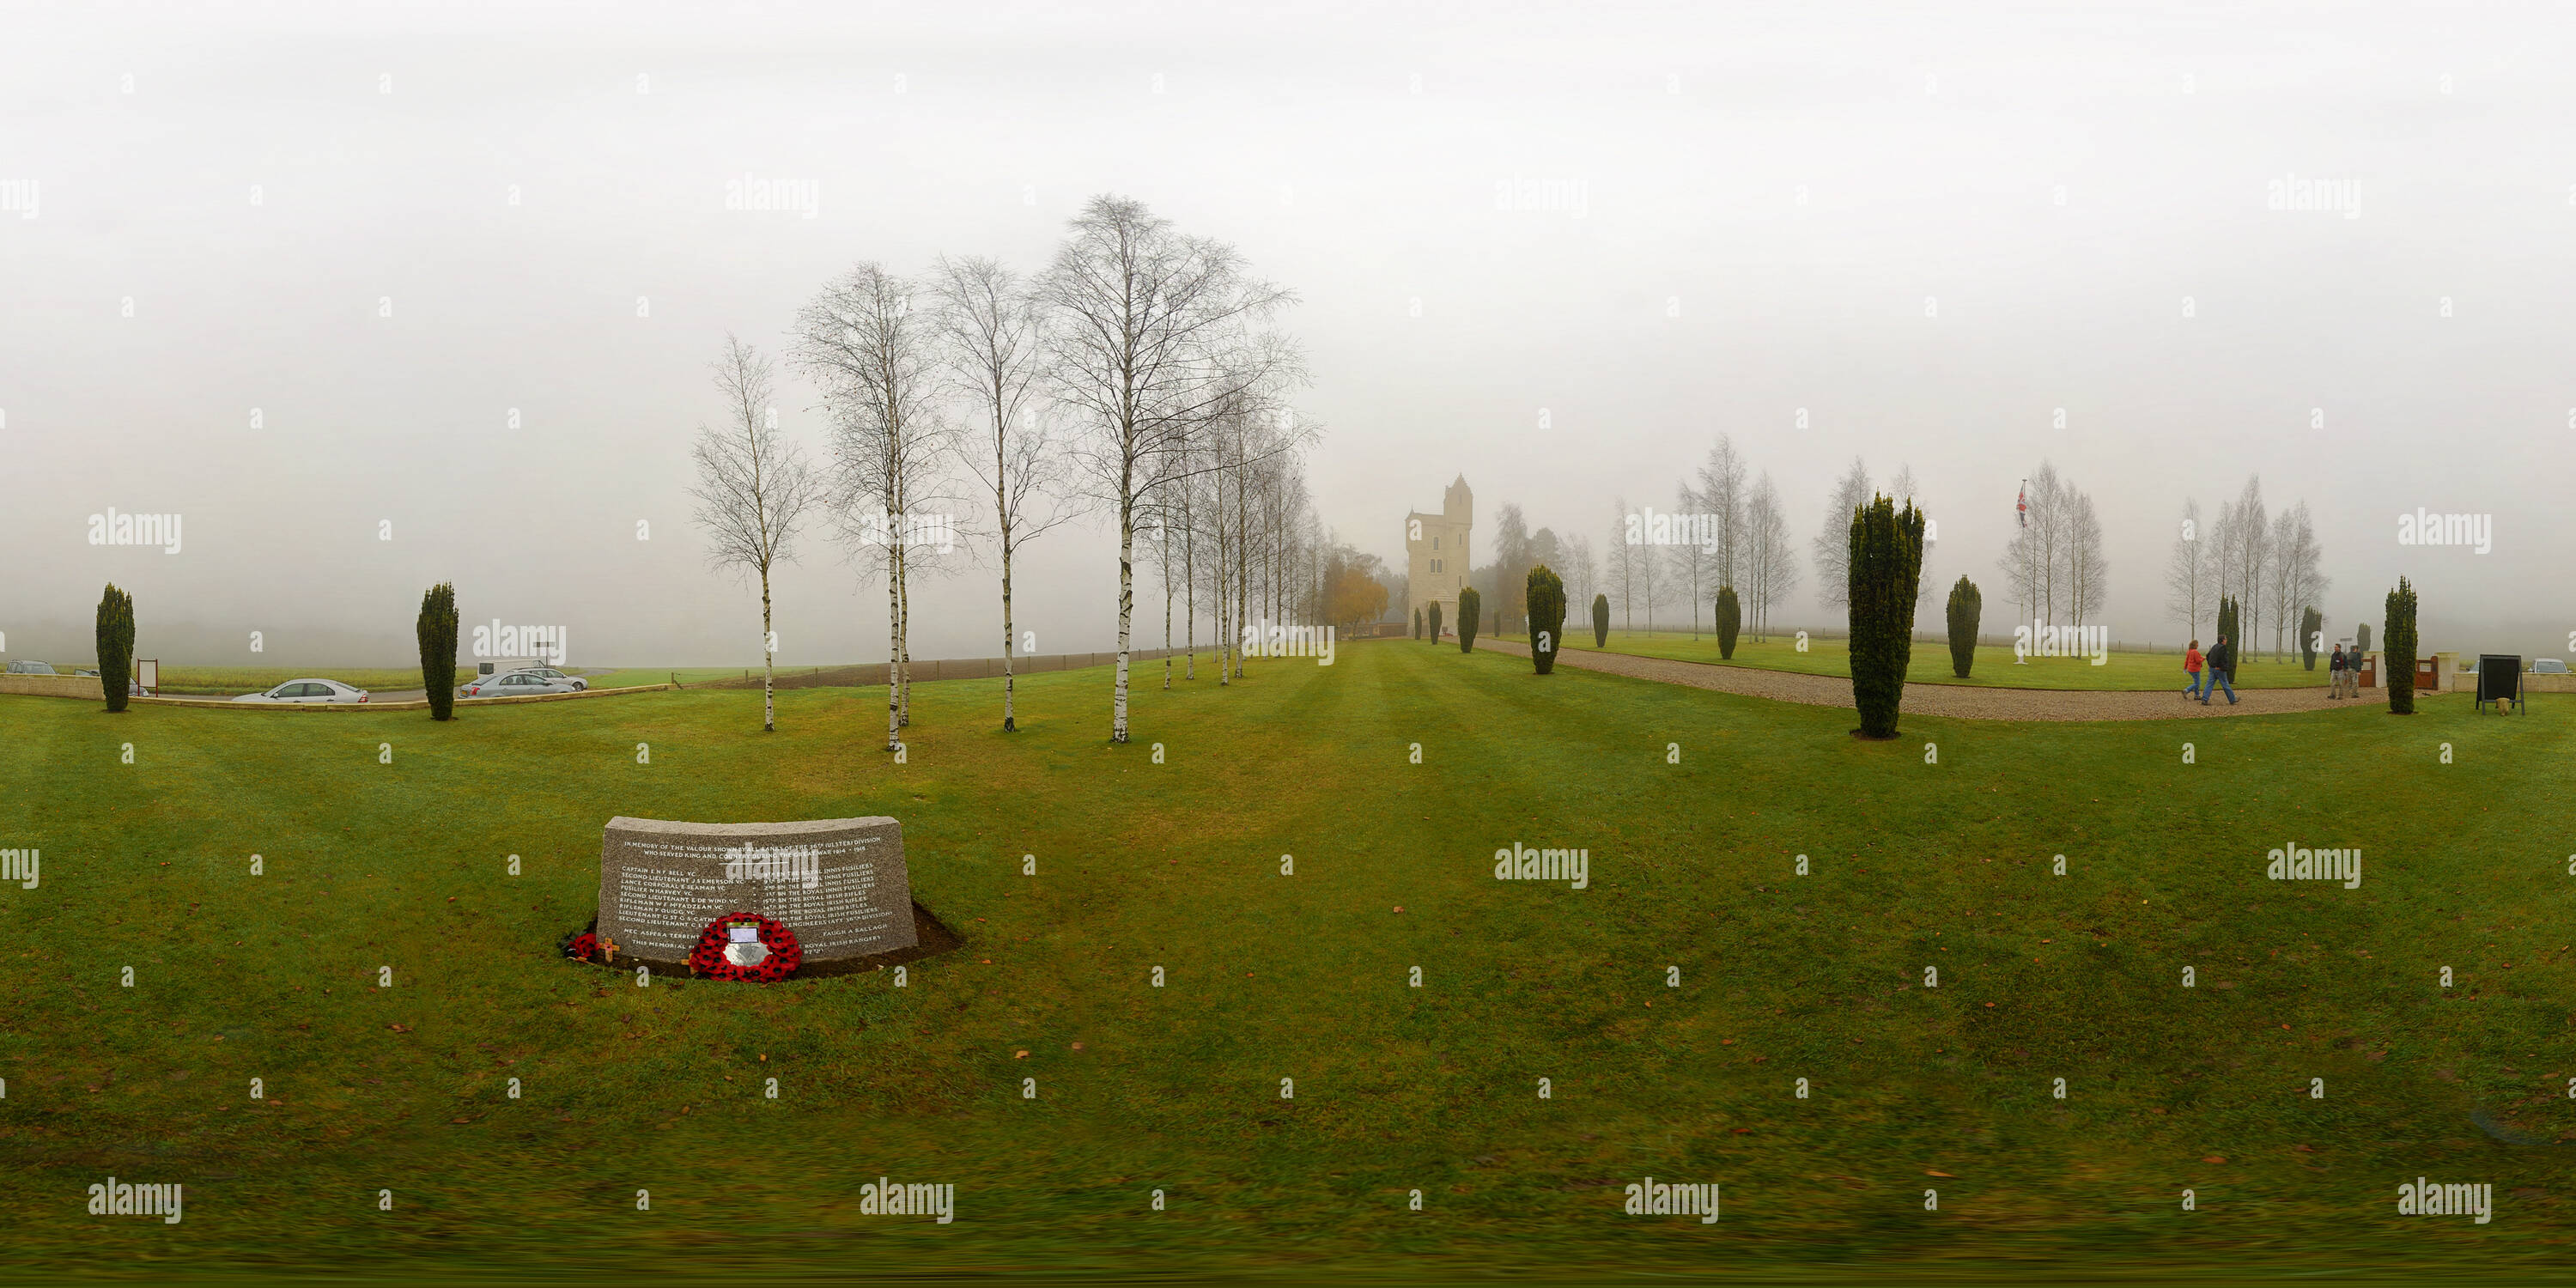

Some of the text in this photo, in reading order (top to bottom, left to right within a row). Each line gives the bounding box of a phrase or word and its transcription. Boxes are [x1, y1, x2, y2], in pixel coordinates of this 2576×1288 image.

[854, 836, 881, 845] DIVISION
[841, 863, 873, 872] FUSILIERS
[843, 876, 874, 884] FUSILIERS
[843, 883, 875, 891] FUSILIERS
[844, 890, 866, 898] RIFLES
[620, 897, 654, 906] RIFLEMAN
[619, 903, 653, 912] RIFLEMAN
[618, 910, 661, 919] LIEUTENANT
[847, 907, 878, 916] FUSILIERS
[647, 919, 689, 927] LIEUTENANT
[855, 924, 888, 933] BALLAGH
[848, 935, 881, 945] RANGERS
[649, 941, 687, 950] MEMORIAL
